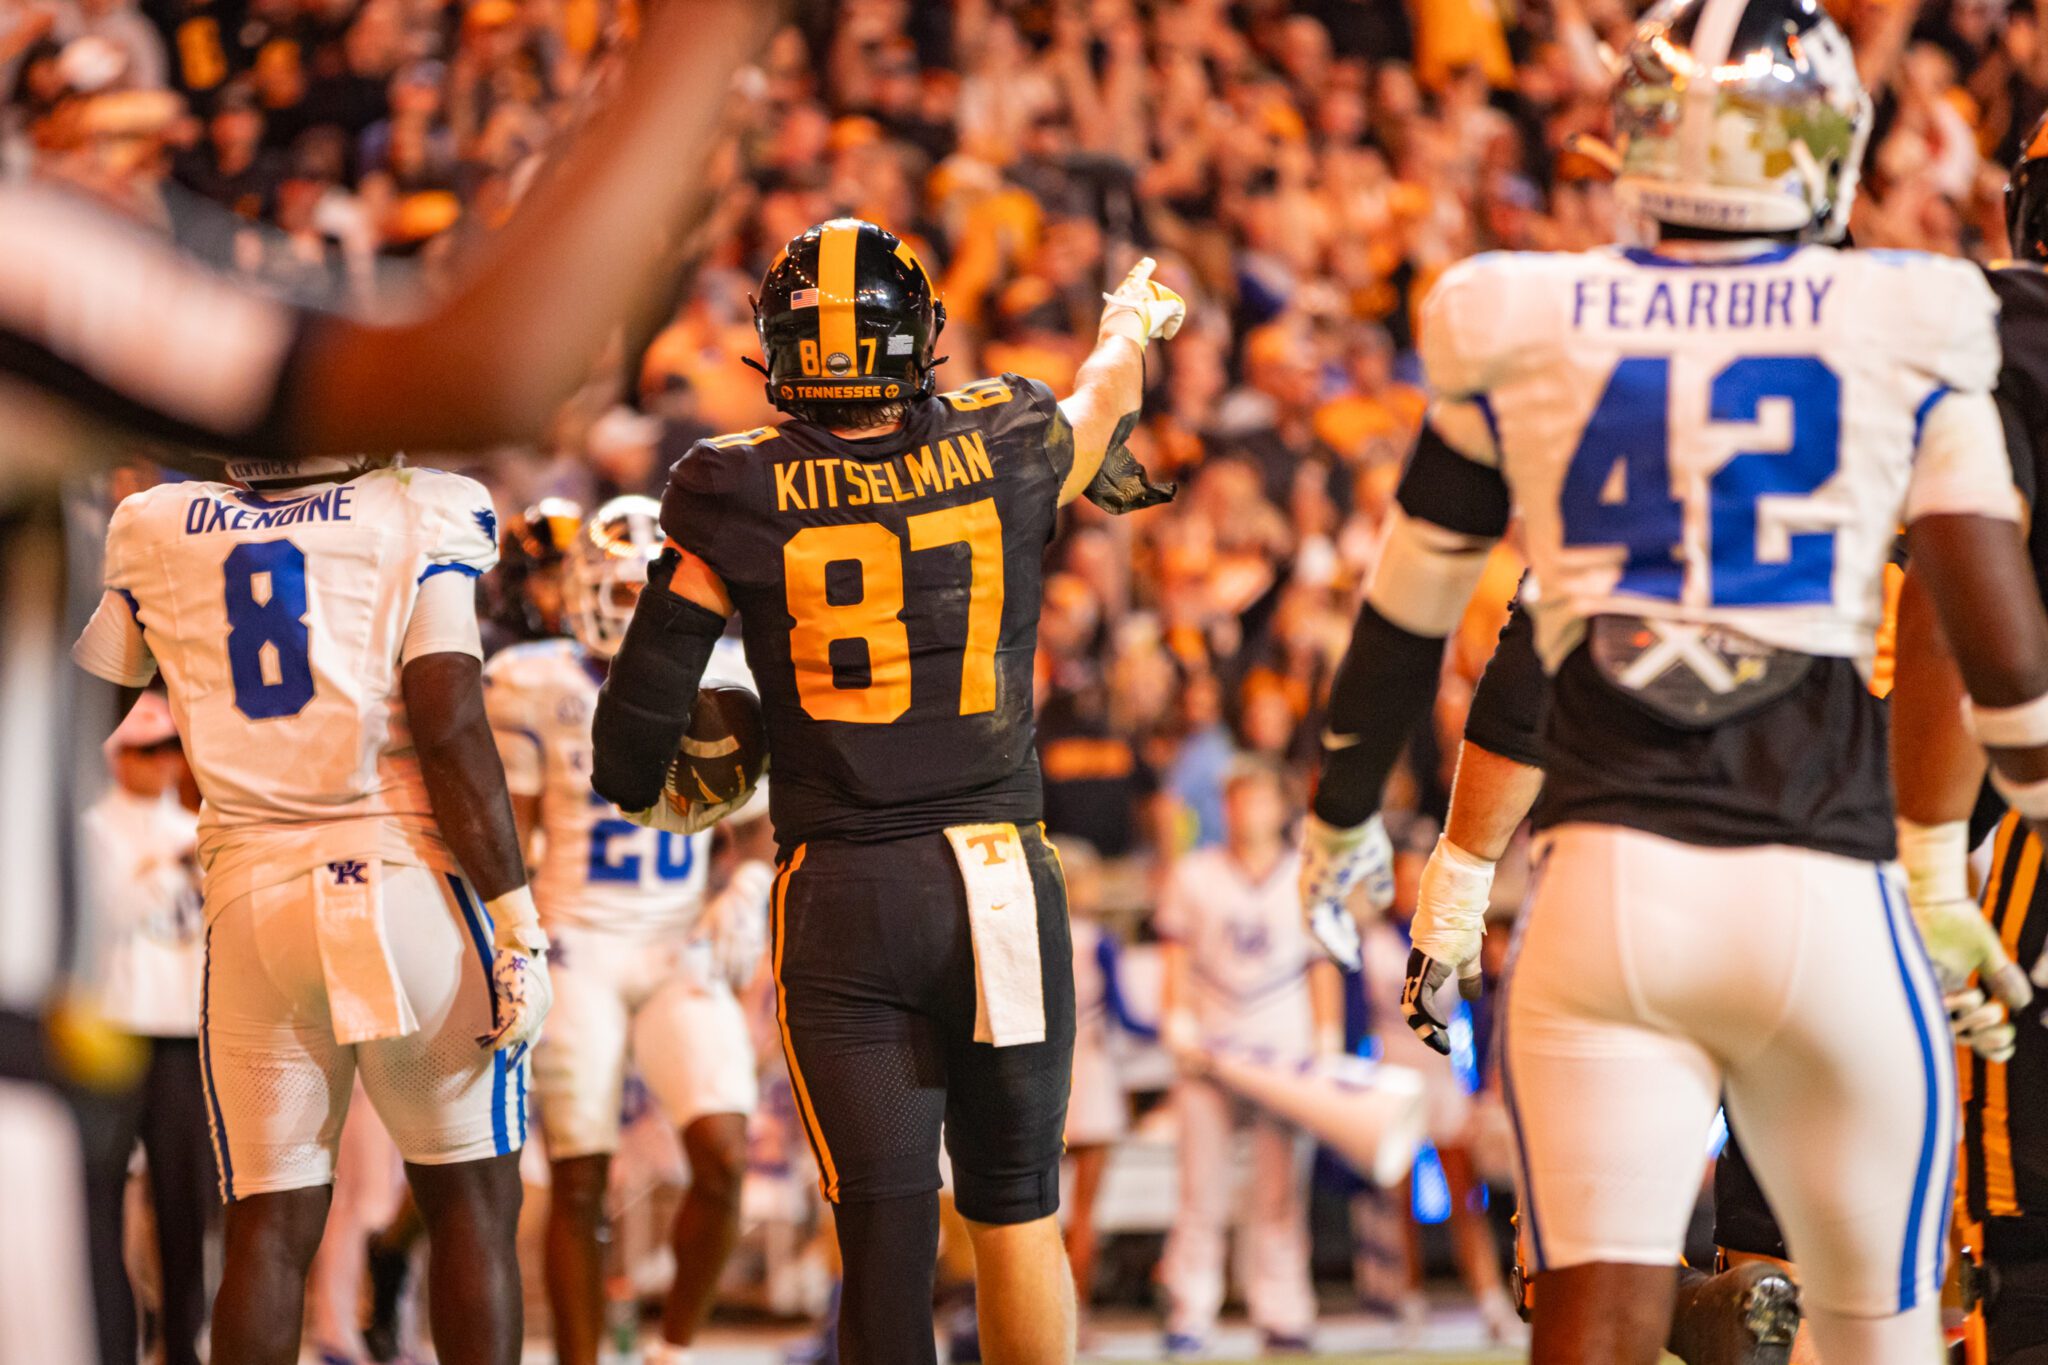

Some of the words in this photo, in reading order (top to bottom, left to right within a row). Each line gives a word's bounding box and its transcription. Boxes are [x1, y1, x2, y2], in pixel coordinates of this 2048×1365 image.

[1573, 275, 1833, 328] FEARBRY
[797, 385, 881, 399] TENNESSEE
[773, 431, 994, 512] KITSELMAN
[1559, 354, 1842, 607] 42
[185, 486, 355, 535] OXENDINE
[222, 538, 317, 722] 8
[783, 497, 1005, 725] 87
[966, 832, 1010, 866] T
